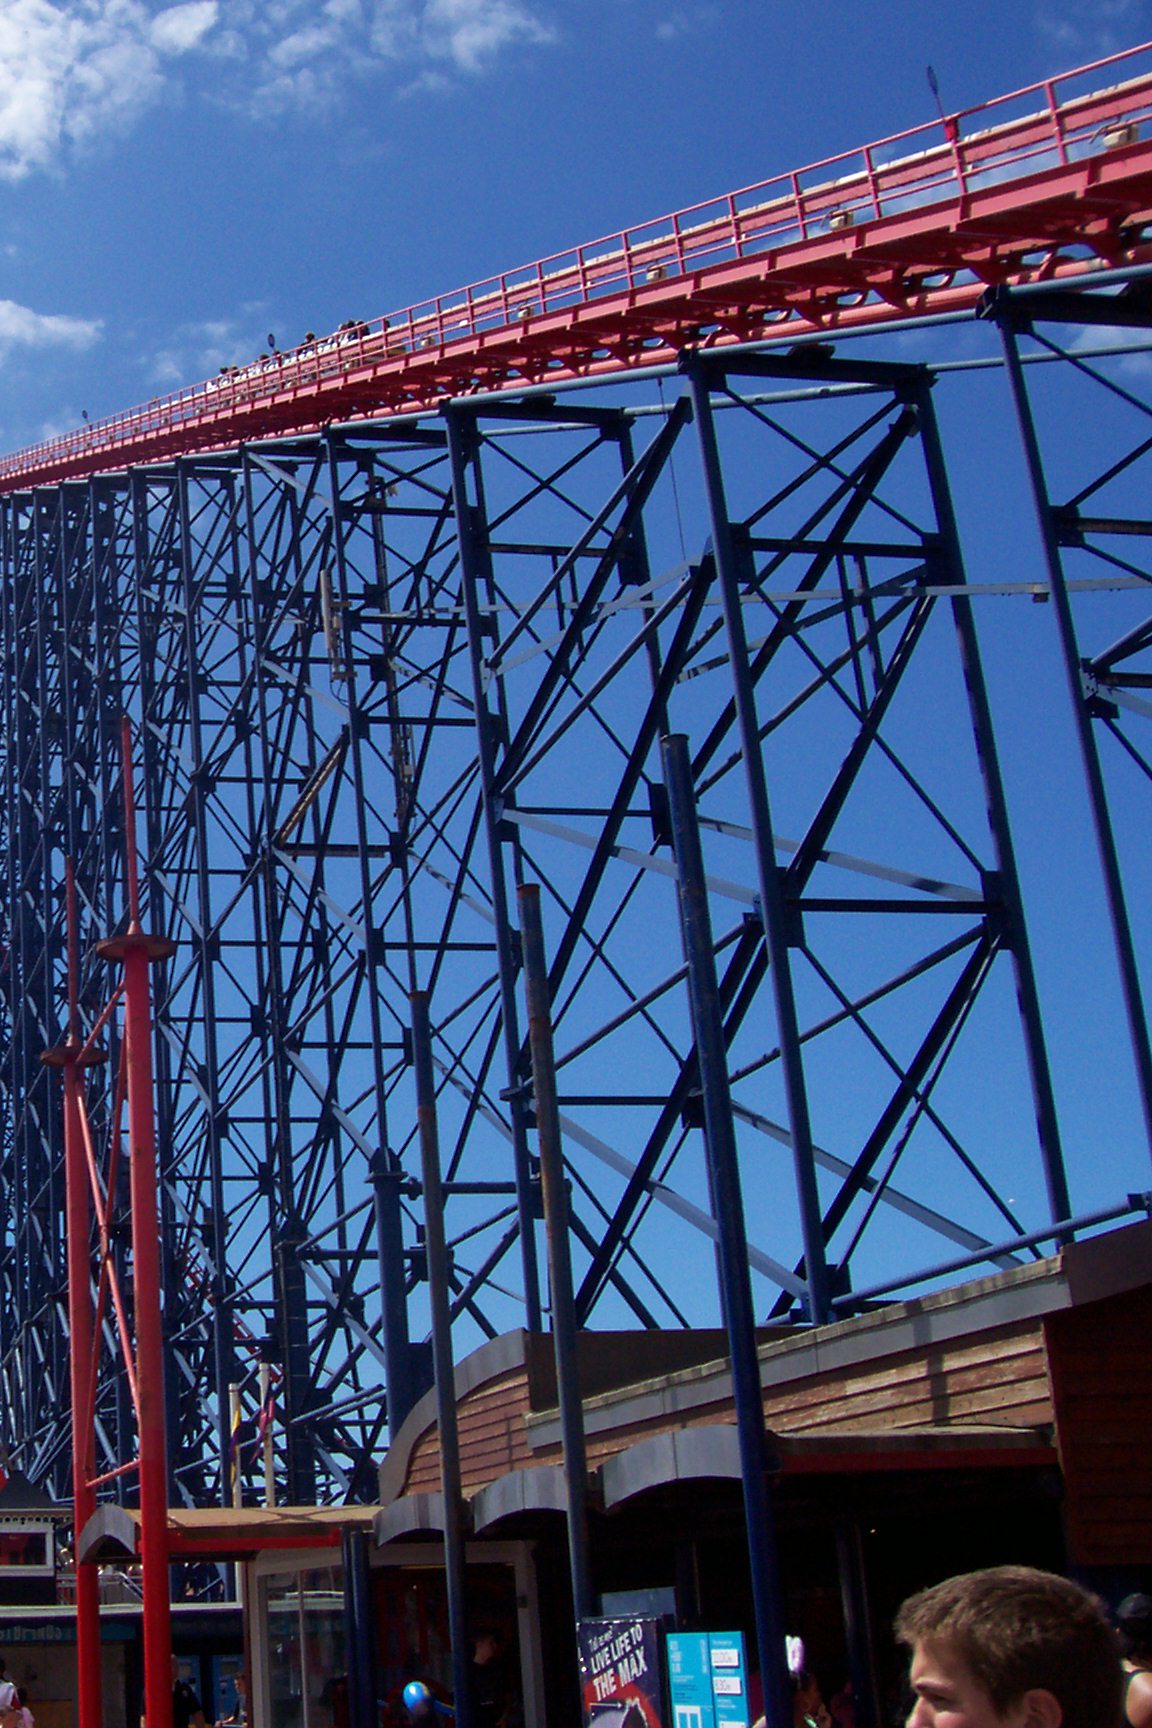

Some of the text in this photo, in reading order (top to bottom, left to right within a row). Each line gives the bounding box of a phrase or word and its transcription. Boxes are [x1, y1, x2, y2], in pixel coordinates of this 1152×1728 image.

[591, 1647, 611, 1674] LIVE
[610, 1631, 631, 1661] LIFE
[630, 1623, 643, 1645] TO
[593, 1668, 617, 1702] THE
[618, 1646, 648, 1687] MAX
